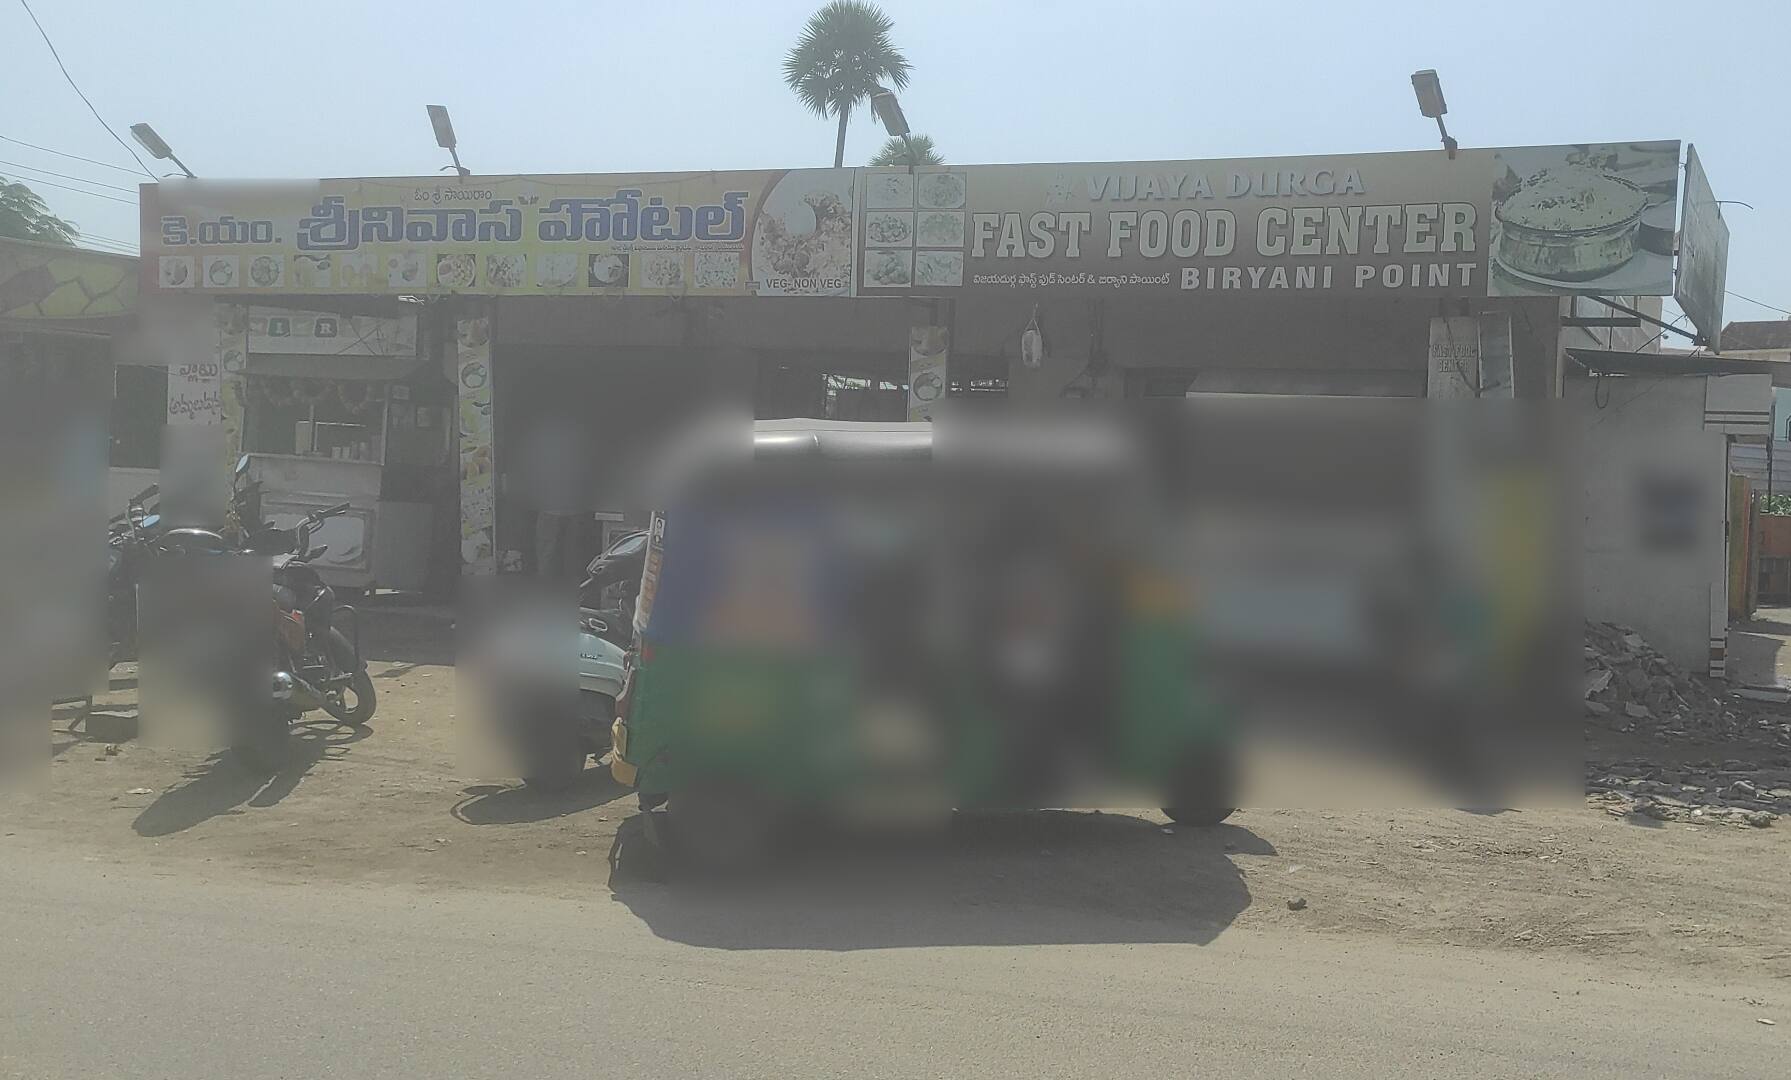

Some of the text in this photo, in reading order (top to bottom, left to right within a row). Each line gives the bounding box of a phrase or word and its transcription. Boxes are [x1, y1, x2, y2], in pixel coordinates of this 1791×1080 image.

[414, 188, 430, 201] ఓం
[1086, 169, 1366, 200] VIJAYA DURGA
[296, 196, 523, 251] శ్రీనివాస
[537, 188, 749, 242] హోటల్
[971, 202, 1478, 259] FAST FOOD CENTER
[793, 278, 816, 289] NON
[820, 278, 842, 289] VEG
[1087, 273, 1096, 285] &
[1180, 263, 1478, 290] BIRYANI POINT
